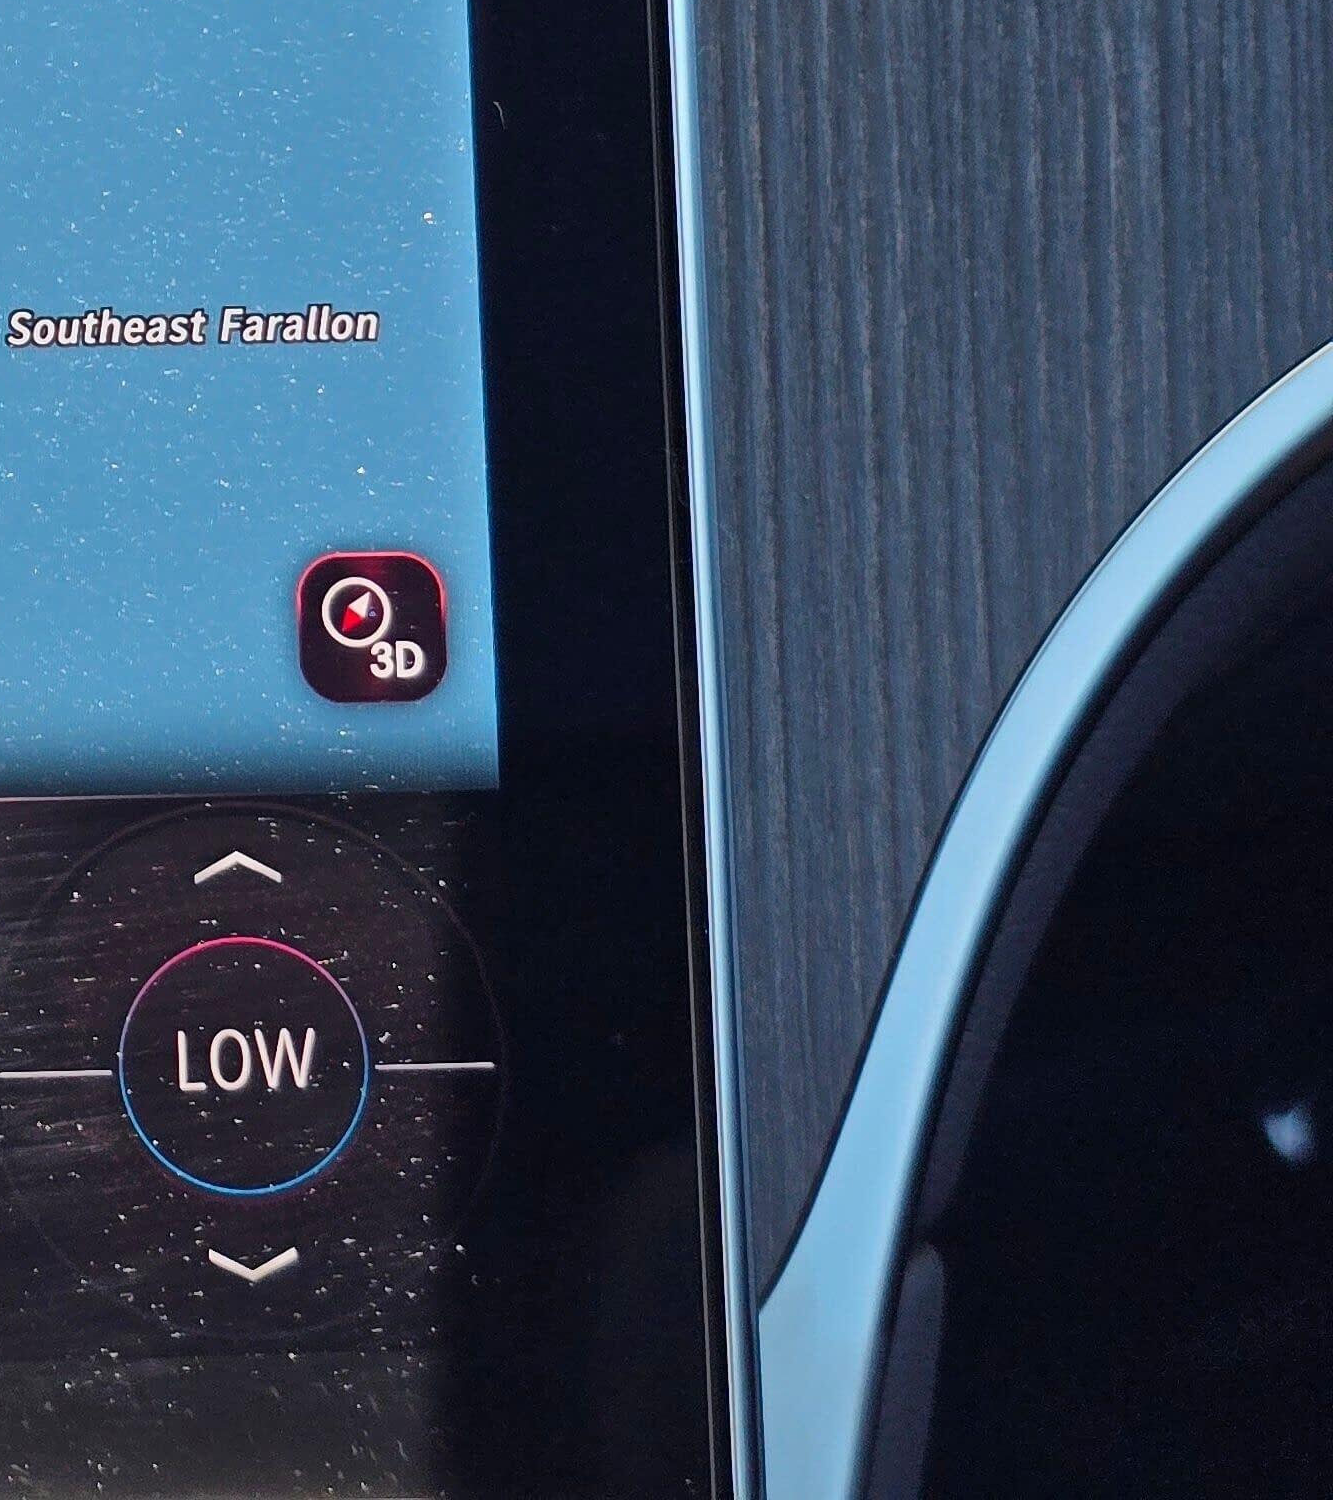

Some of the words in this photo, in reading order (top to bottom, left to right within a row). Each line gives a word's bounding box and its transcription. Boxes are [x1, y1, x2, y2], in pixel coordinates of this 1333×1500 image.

[6, 308, 207, 347] Southeast
[219, 306, 379, 344] Farallon
[368, 639, 426, 680] 3D
[177, 1027, 317, 1092] LOW
